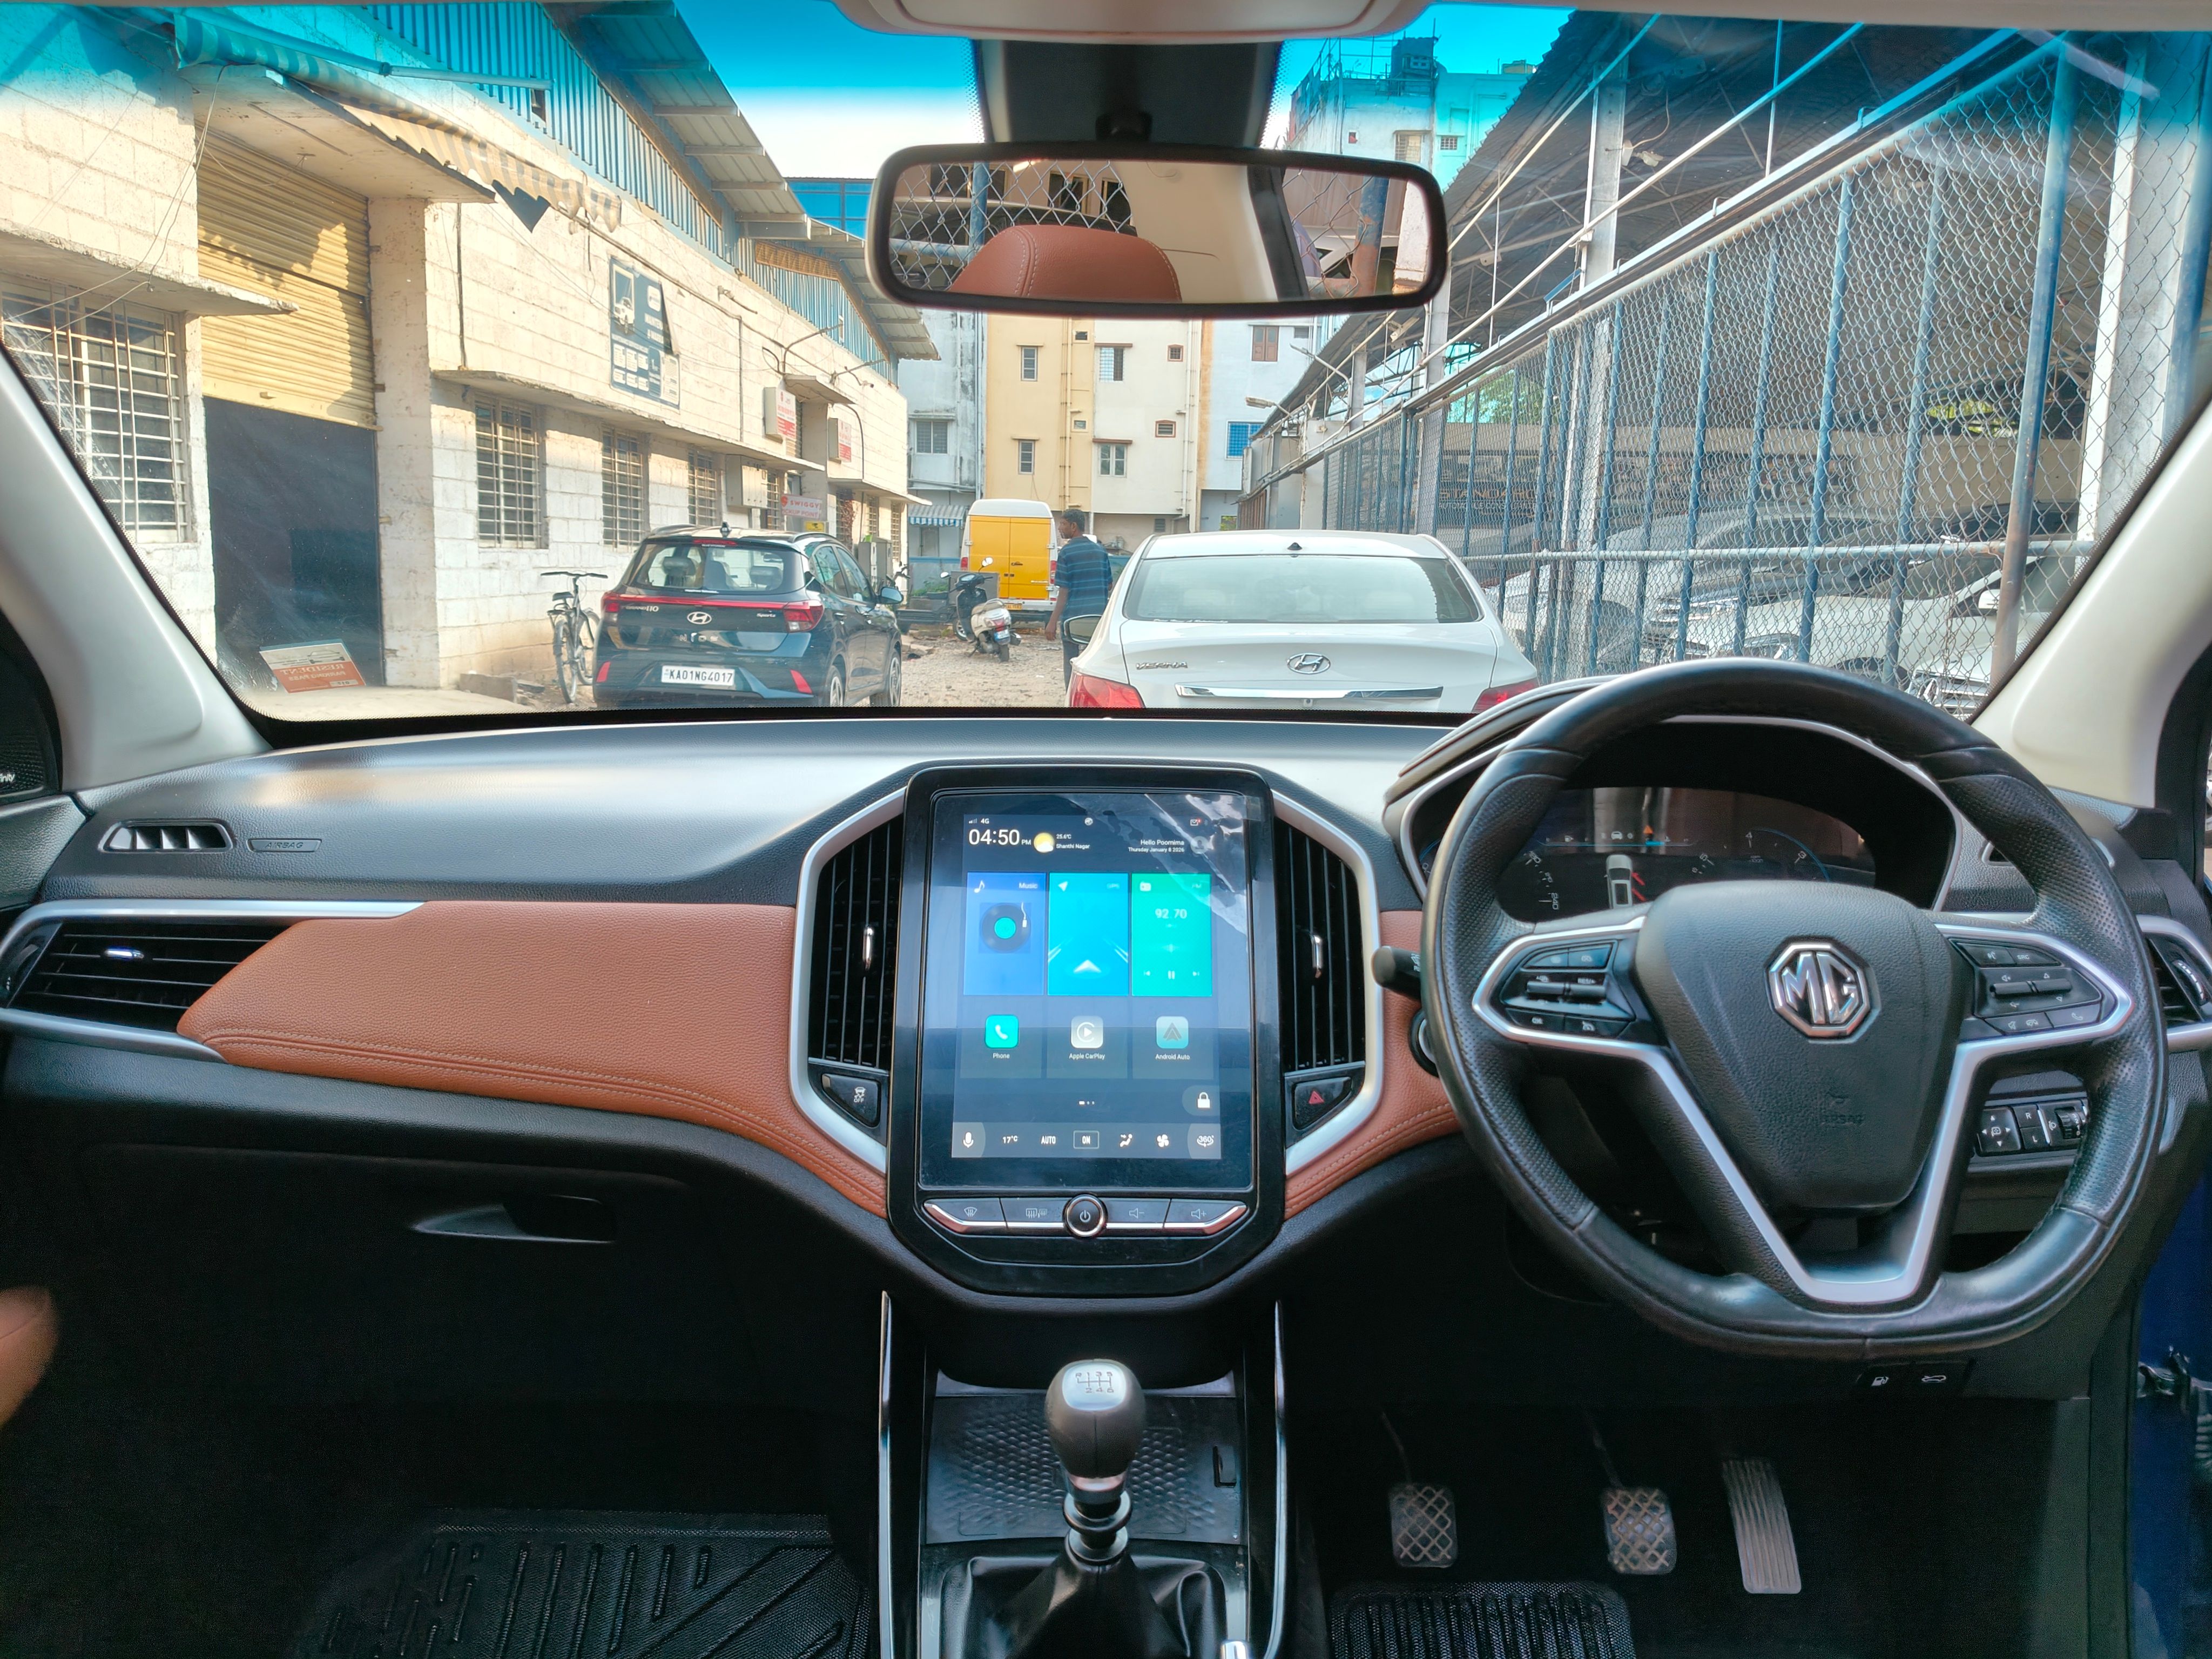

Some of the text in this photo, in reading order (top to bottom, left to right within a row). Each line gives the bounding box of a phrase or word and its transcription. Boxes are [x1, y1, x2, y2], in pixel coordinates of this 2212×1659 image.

[790, 500, 819, 508] SWIGGY
[1136, 662, 1188, 670] VERNA
[669, 669, 733, 683] KA01NG4017
[969, 829, 1020, 845] 04:50
[1782, 952, 1859, 1024] MG
[1041, 1136, 1056, 1144] AUTO
[1082, 1136, 1090, 1144] ON
